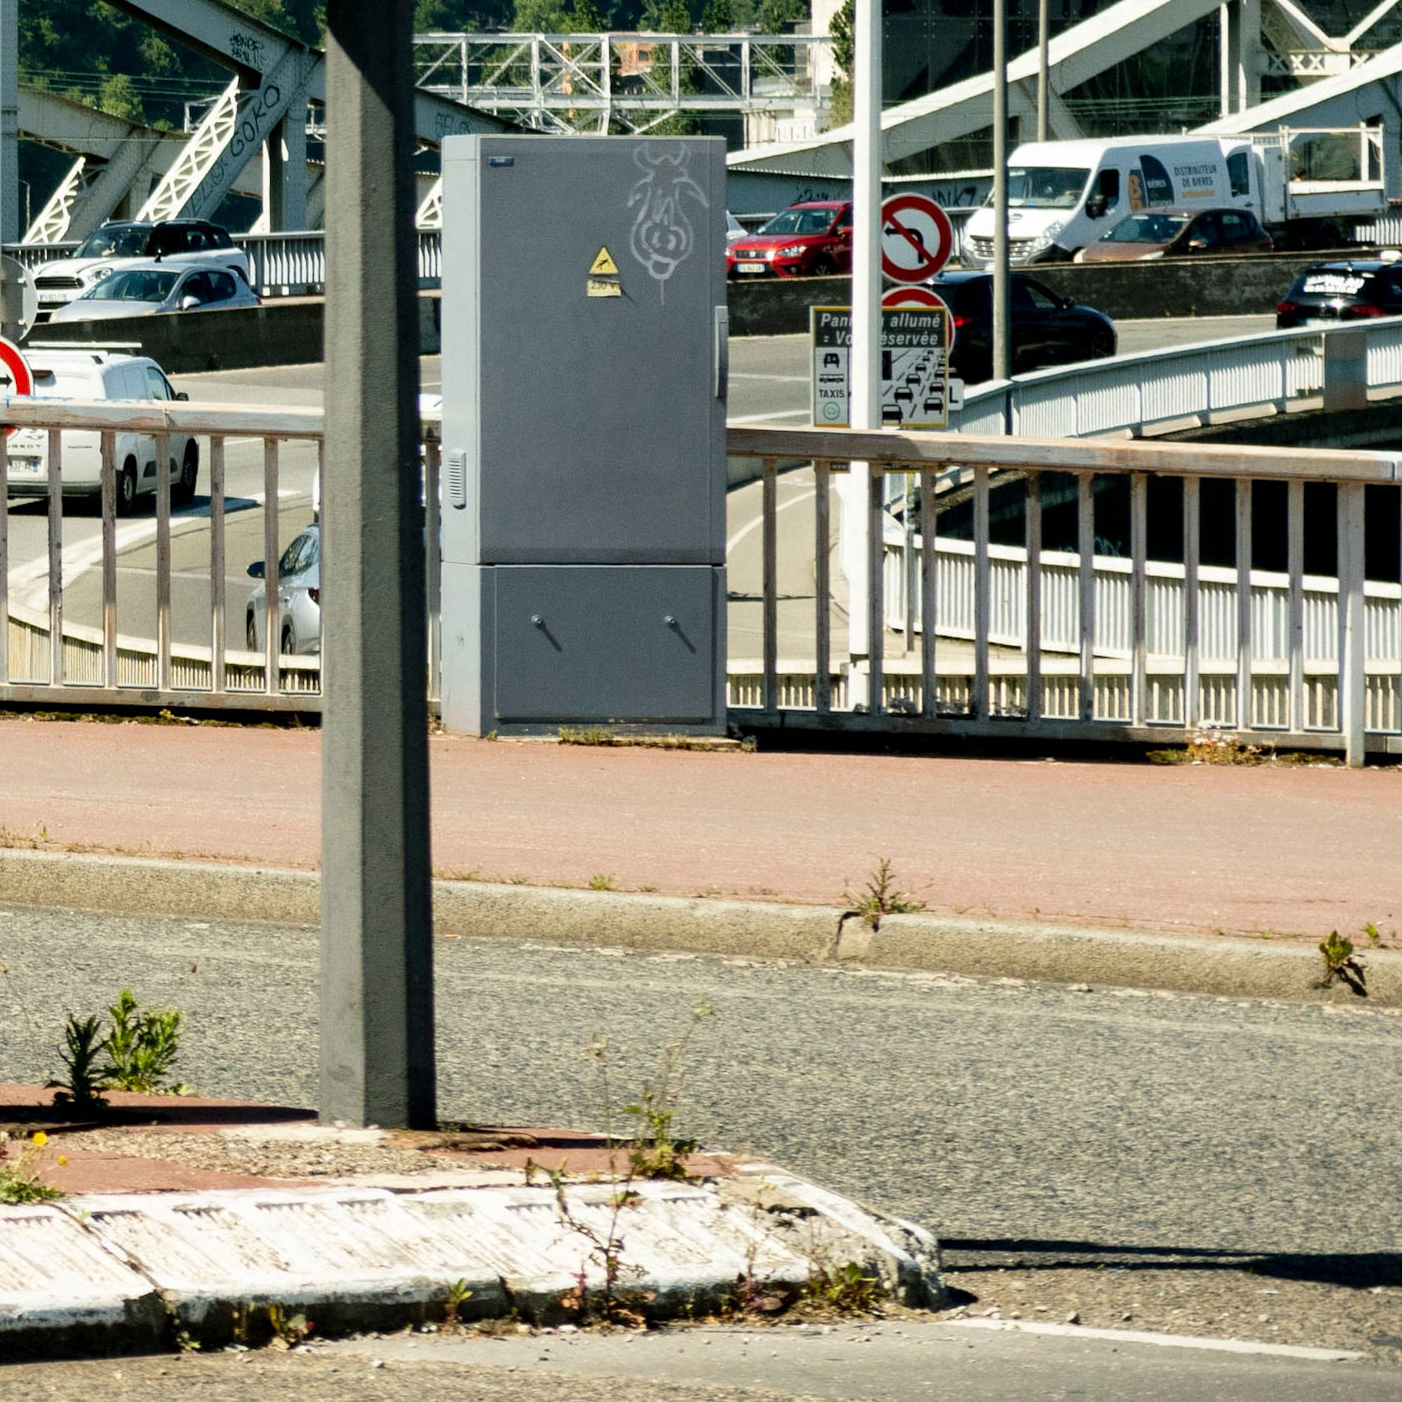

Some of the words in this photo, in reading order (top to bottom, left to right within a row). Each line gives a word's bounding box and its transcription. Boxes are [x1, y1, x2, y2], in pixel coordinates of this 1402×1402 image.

[890, 313, 941, 328] allumé
[881, 331, 939, 345] éservée
[819, 389, 845, 399] TAXIS
